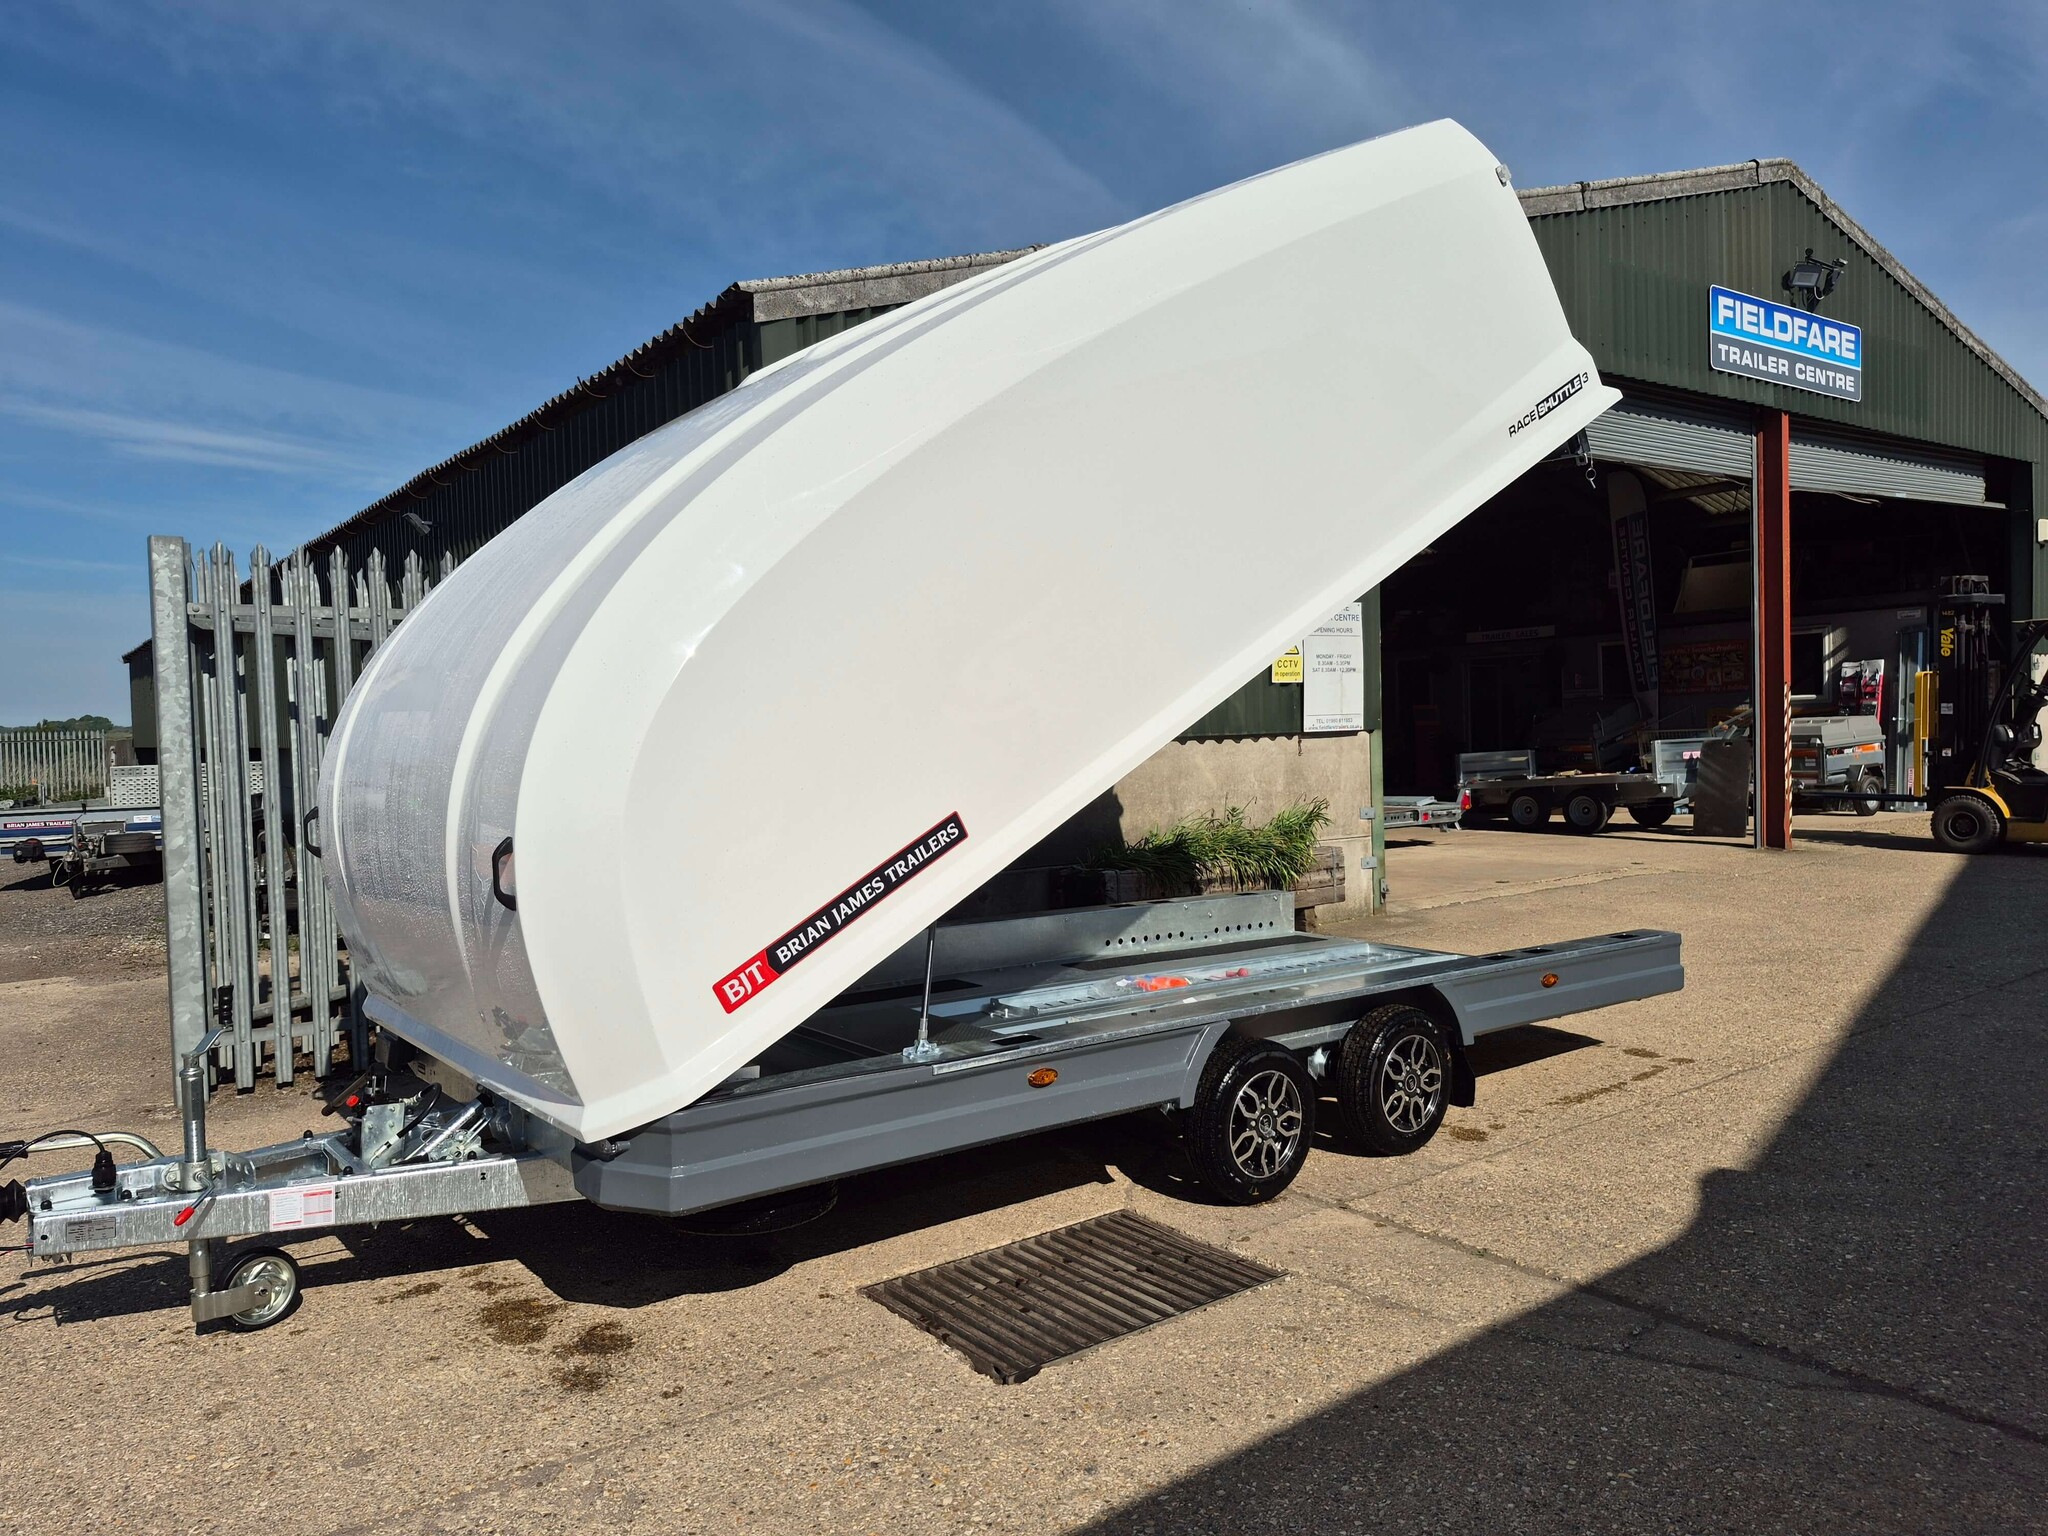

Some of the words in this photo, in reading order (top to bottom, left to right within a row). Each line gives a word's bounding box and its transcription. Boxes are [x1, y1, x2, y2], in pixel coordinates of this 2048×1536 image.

[1718, 295, 1856, 360] FIELDFARE
[1718, 344, 1789, 376] TRAILER
[1795, 362, 1855, 392] CENTRE
[1508, 409, 1537, 437] RACE
[1538, 377, 1582, 418] SHUTTLE
[1582, 372, 1589, 384] 3
[1334, 614, 1360, 622] CENTRE
[1940, 627, 1954, 657] Yale
[1277, 660, 1299, 668] CCTV
[721, 960, 766, 1005] BJT
[774, 915, 832, 965] BRIAN
[831, 876, 885, 926] JAMES
[885, 823, 960, 884] TRAILERS
